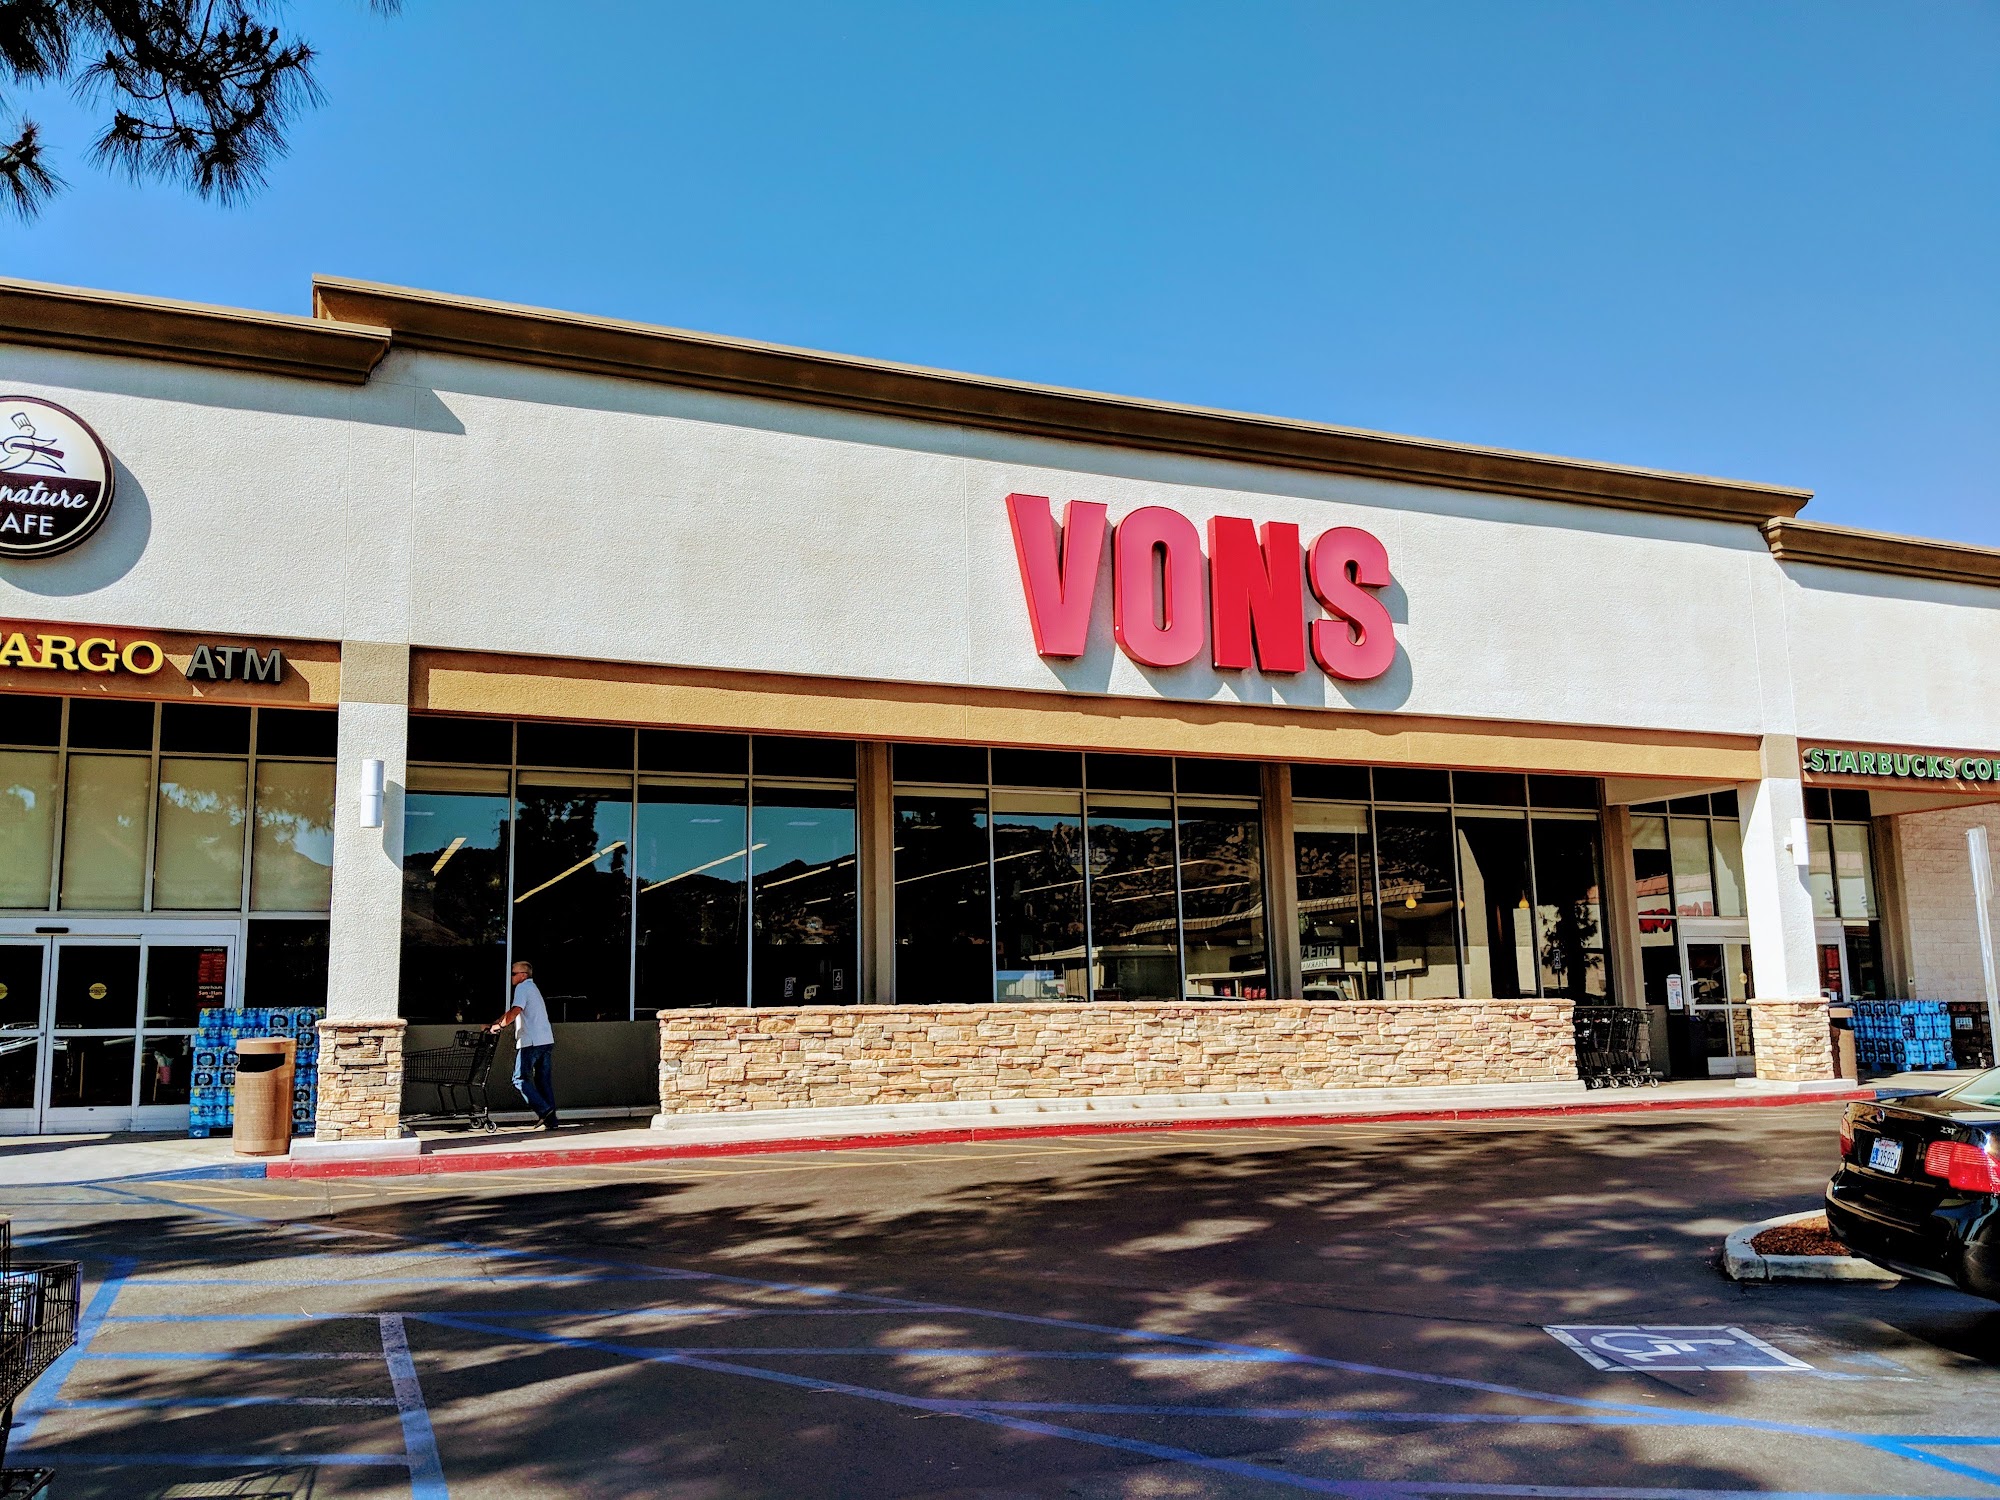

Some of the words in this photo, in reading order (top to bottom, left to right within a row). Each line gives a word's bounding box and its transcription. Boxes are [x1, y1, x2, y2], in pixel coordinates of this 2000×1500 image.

[0, 512, 54, 536] AFE
[1005, 493, 1396, 681] VONS
[0, 632, 164, 675] ARGO
[186, 644, 281, 683] ATM
[1807, 748, 1956, 778] STARBUCKS
